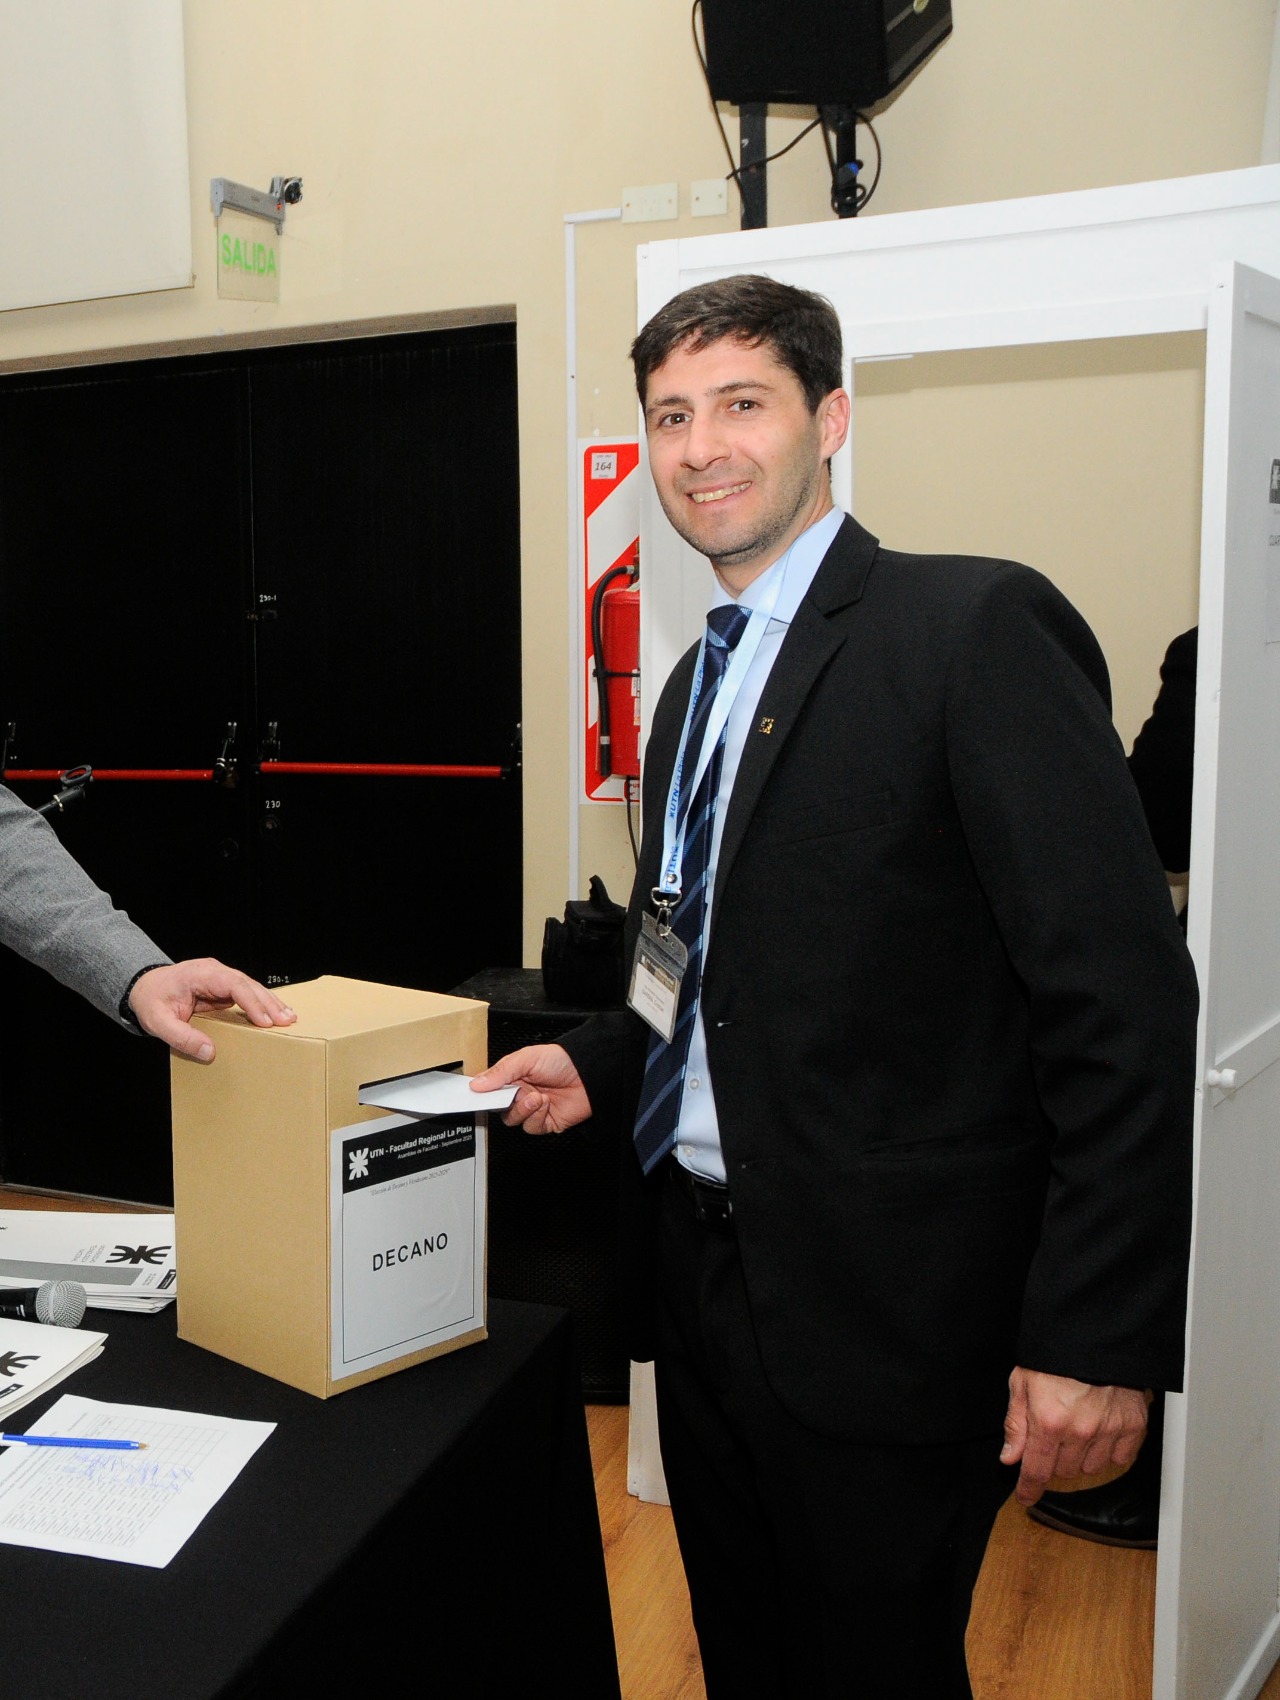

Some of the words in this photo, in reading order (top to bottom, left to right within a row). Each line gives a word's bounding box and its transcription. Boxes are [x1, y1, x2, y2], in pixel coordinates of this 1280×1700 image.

[222, 233, 276, 275] SALIDA
[595, 462, 612, 471] 164
[265, 800, 281, 809] 230
[370, 1148, 384, 1159] UTN
[389, 1138, 418, 1154] Facultad
[418, 1131, 446, 1146] Regional
[447, 1128, 455, 1138] La
[456, 1126, 473, 1135] Plata
[422, 1143, 439, 1153] Facultad
[372, 1232, 448, 1271] DECANO
